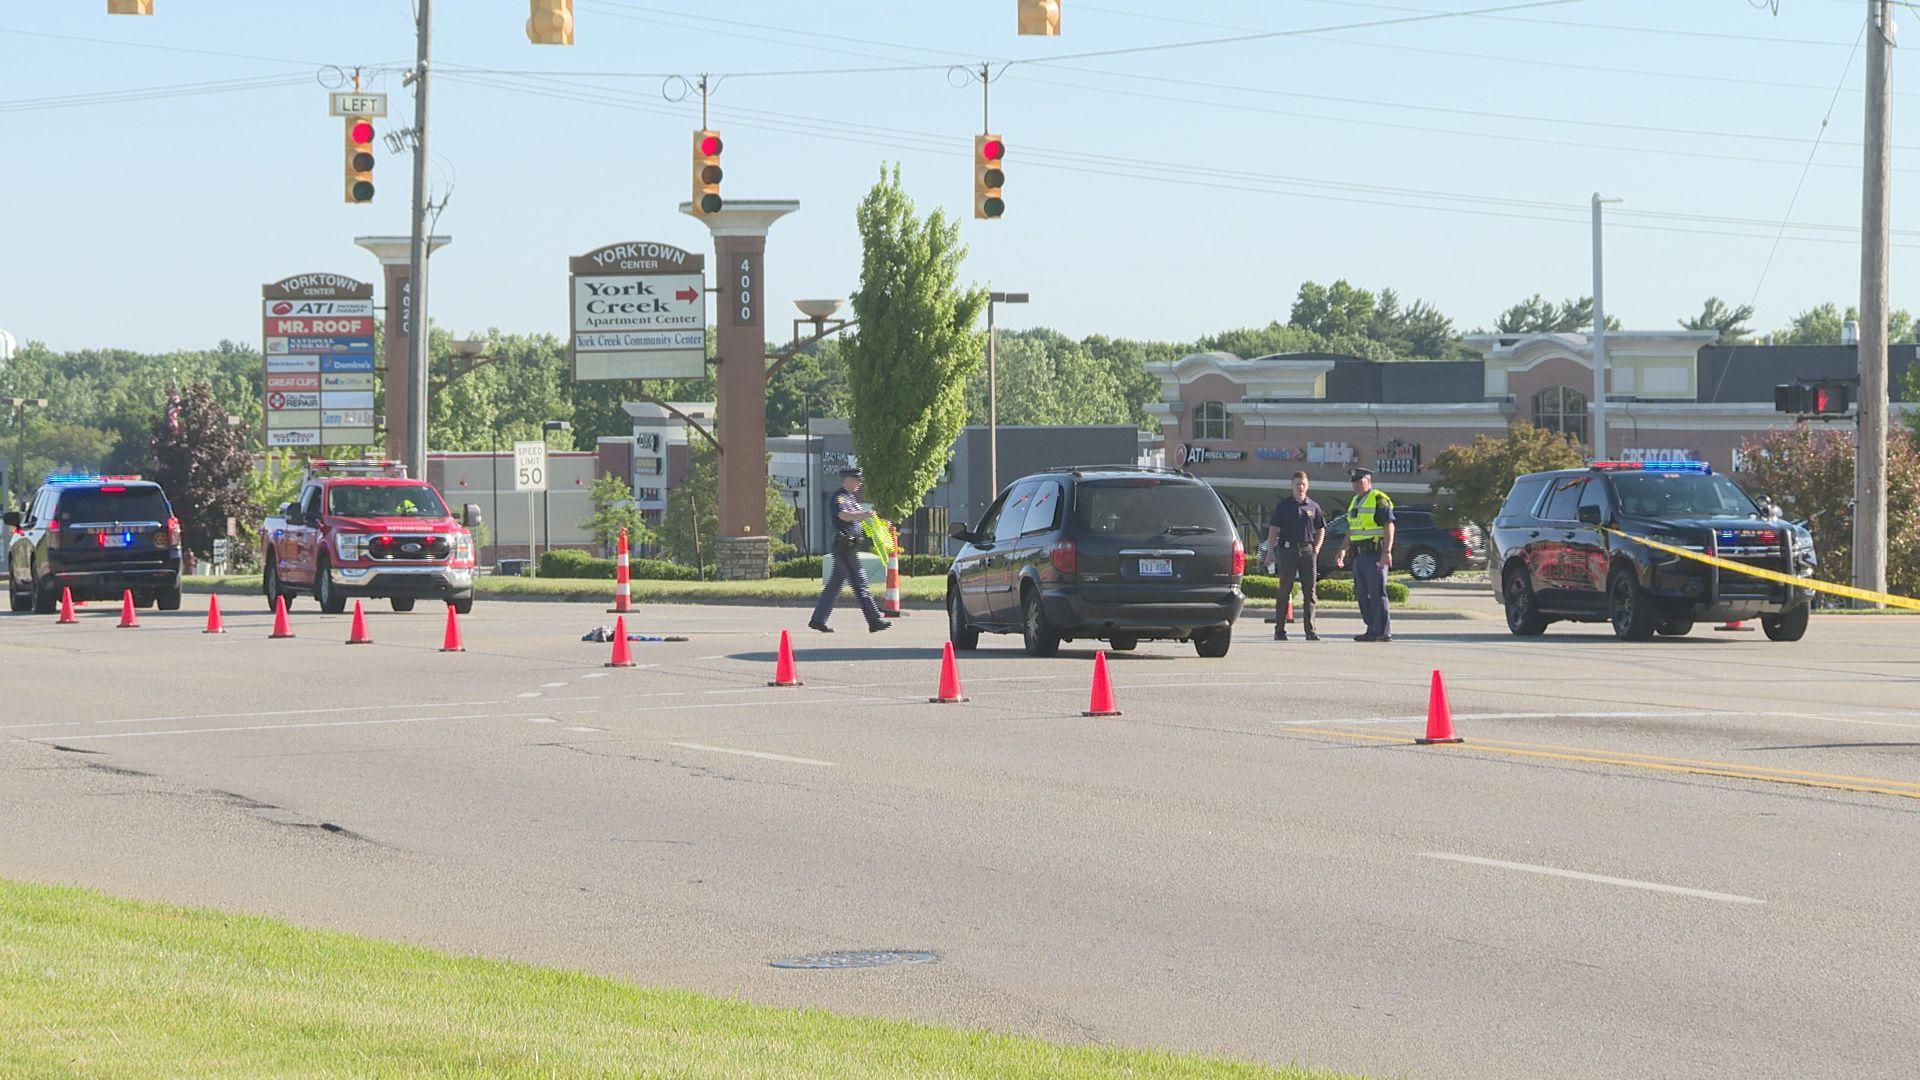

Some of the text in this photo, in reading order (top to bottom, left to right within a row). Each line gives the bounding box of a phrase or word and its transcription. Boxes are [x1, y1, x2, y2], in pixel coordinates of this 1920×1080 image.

[342, 98, 377, 112] LEFT
[593, 244, 686, 266] YORKTOWN
[620, 260, 658, 270] CENTER
[282, 274, 358, 292] YORKTOWN
[584, 281, 656, 296] York
[741, 259, 750, 320] 4000
[296, 303, 334, 314] ATI
[586, 298, 672, 314] Creek
[278, 320, 362, 333] MR. ROOF
[585, 316, 697, 327] Apartment Center
[577, 334, 702, 347] York Creek Community Center
[518, 447, 542, 455] SPEED
[1188, 448, 1205, 462] ATI
[520, 456, 540, 465] LIMIT
[520, 468, 542, 485] 50
